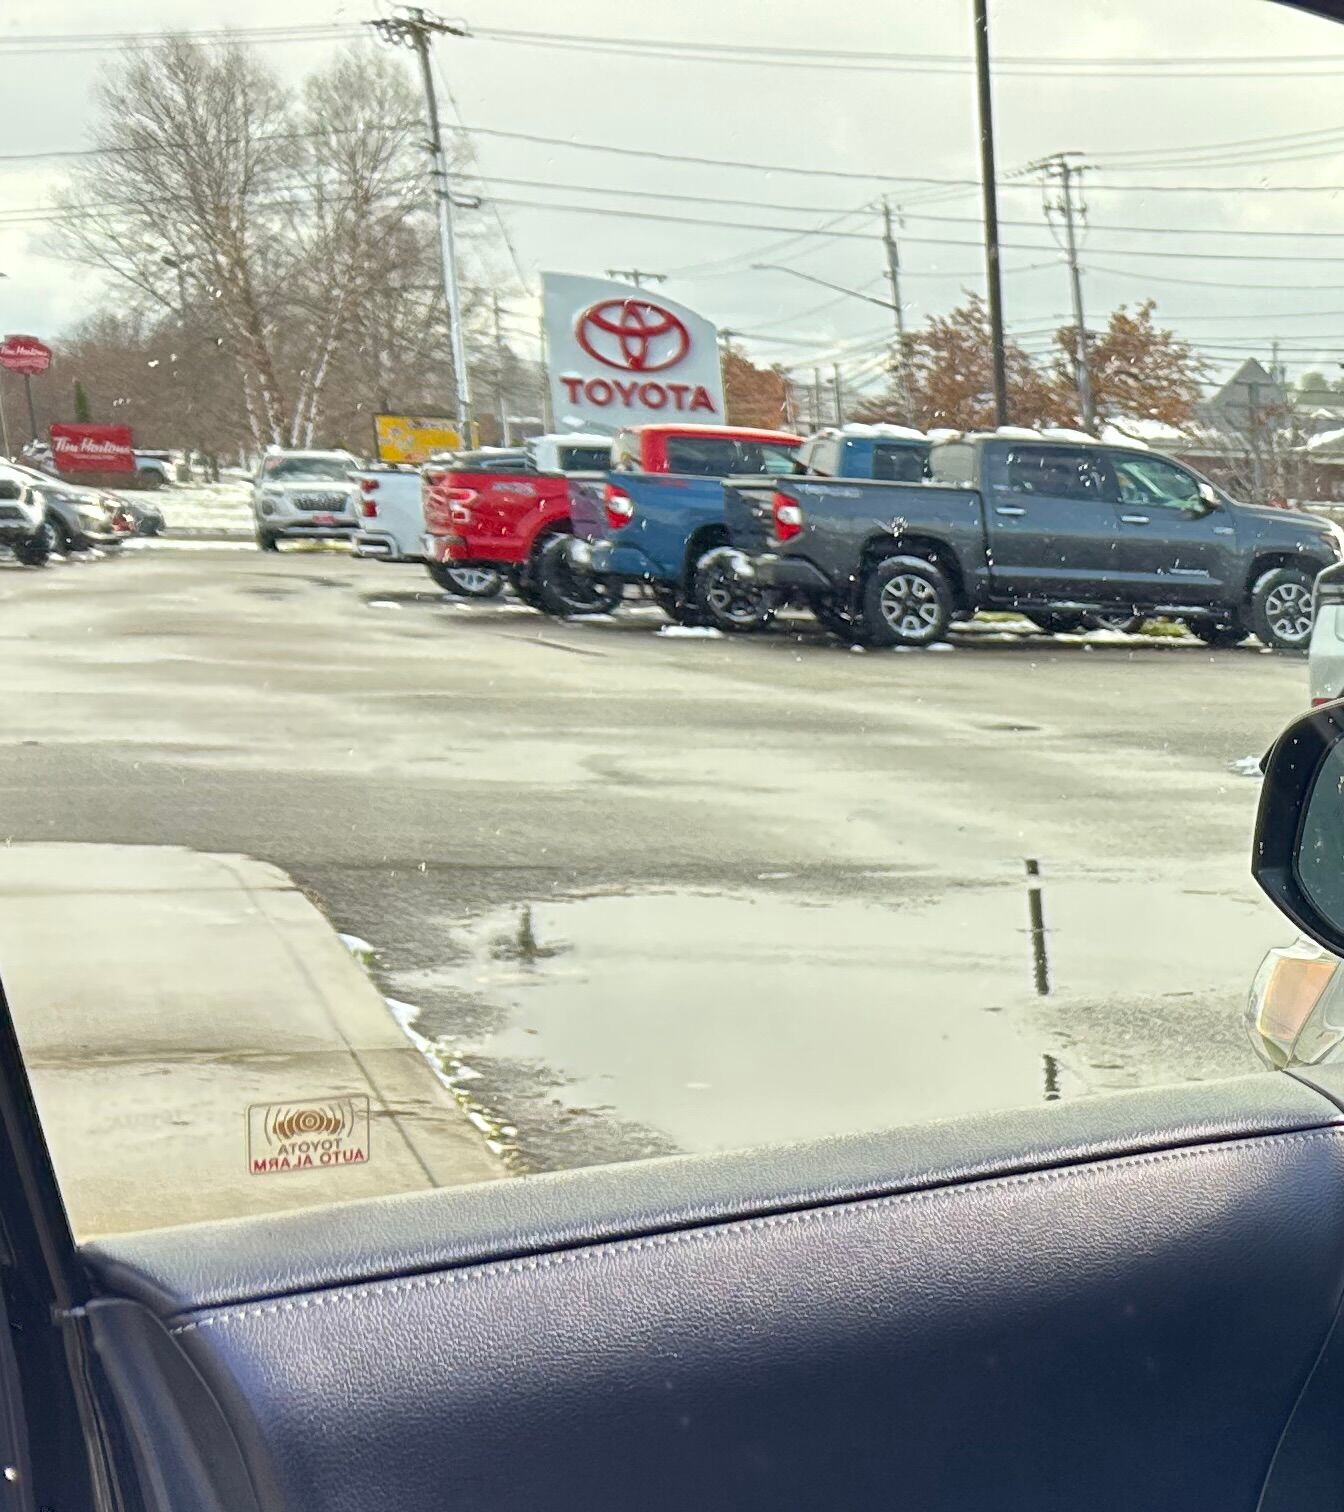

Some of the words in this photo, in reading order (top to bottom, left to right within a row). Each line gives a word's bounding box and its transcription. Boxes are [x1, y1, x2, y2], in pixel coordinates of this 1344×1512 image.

[560, 376, 717, 413] TOYOTA
[52, 436, 79, 452] Tim
[80, 437, 131, 454] Hortons
